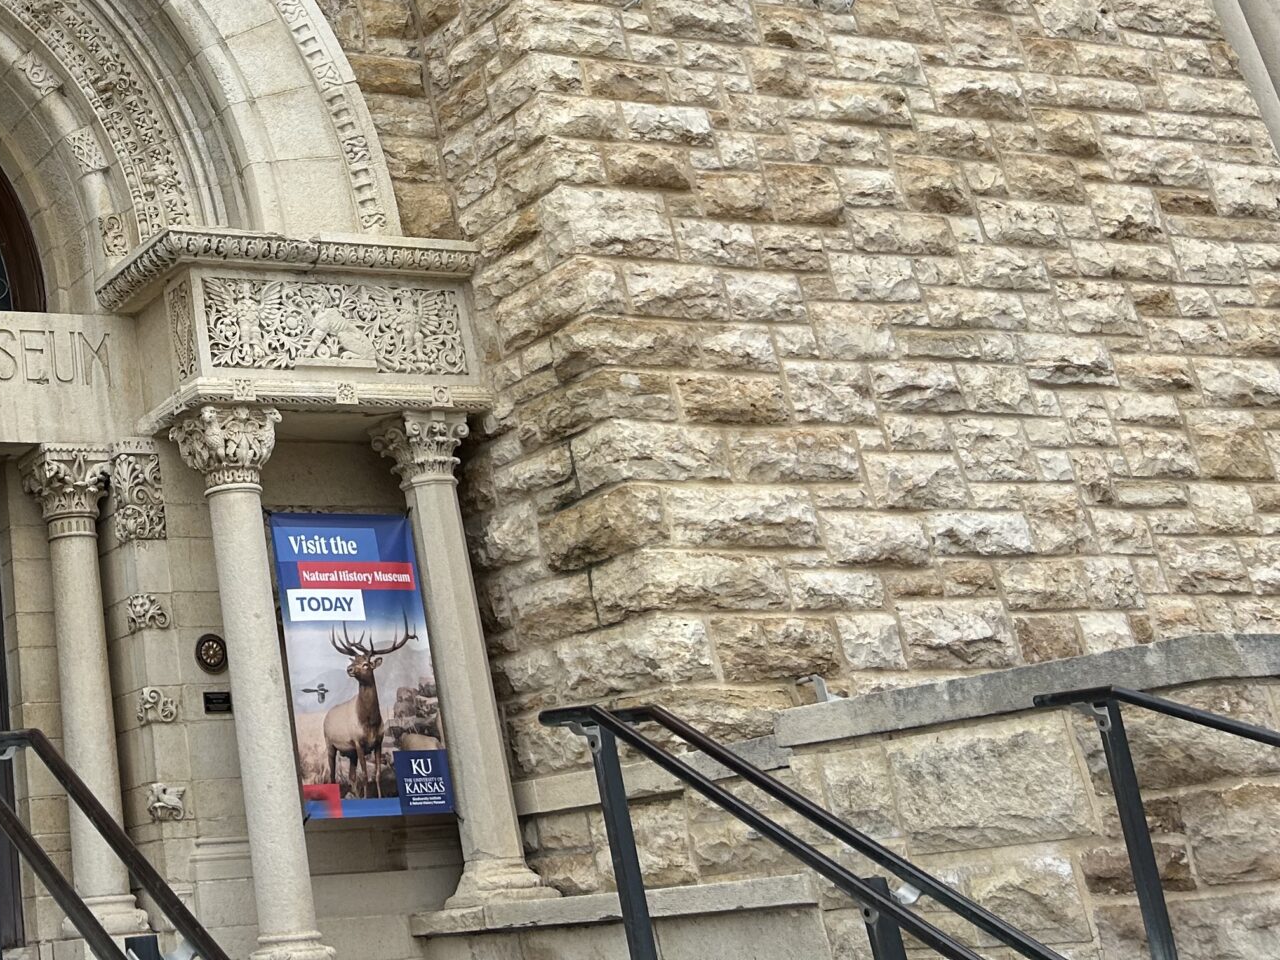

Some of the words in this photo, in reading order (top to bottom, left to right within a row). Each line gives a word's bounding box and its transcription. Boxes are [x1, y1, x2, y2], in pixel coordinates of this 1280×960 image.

[288, 534, 329, 555] Visit
[329, 536, 358, 555] the
[302, 570, 338, 582] Natural
[339, 570, 373, 585] History
[373, 571, 411, 583] Museum
[296, 597, 354, 612] TODAY
[410, 758, 432, 777] KU
[405, 781, 446, 794] KANSAS
